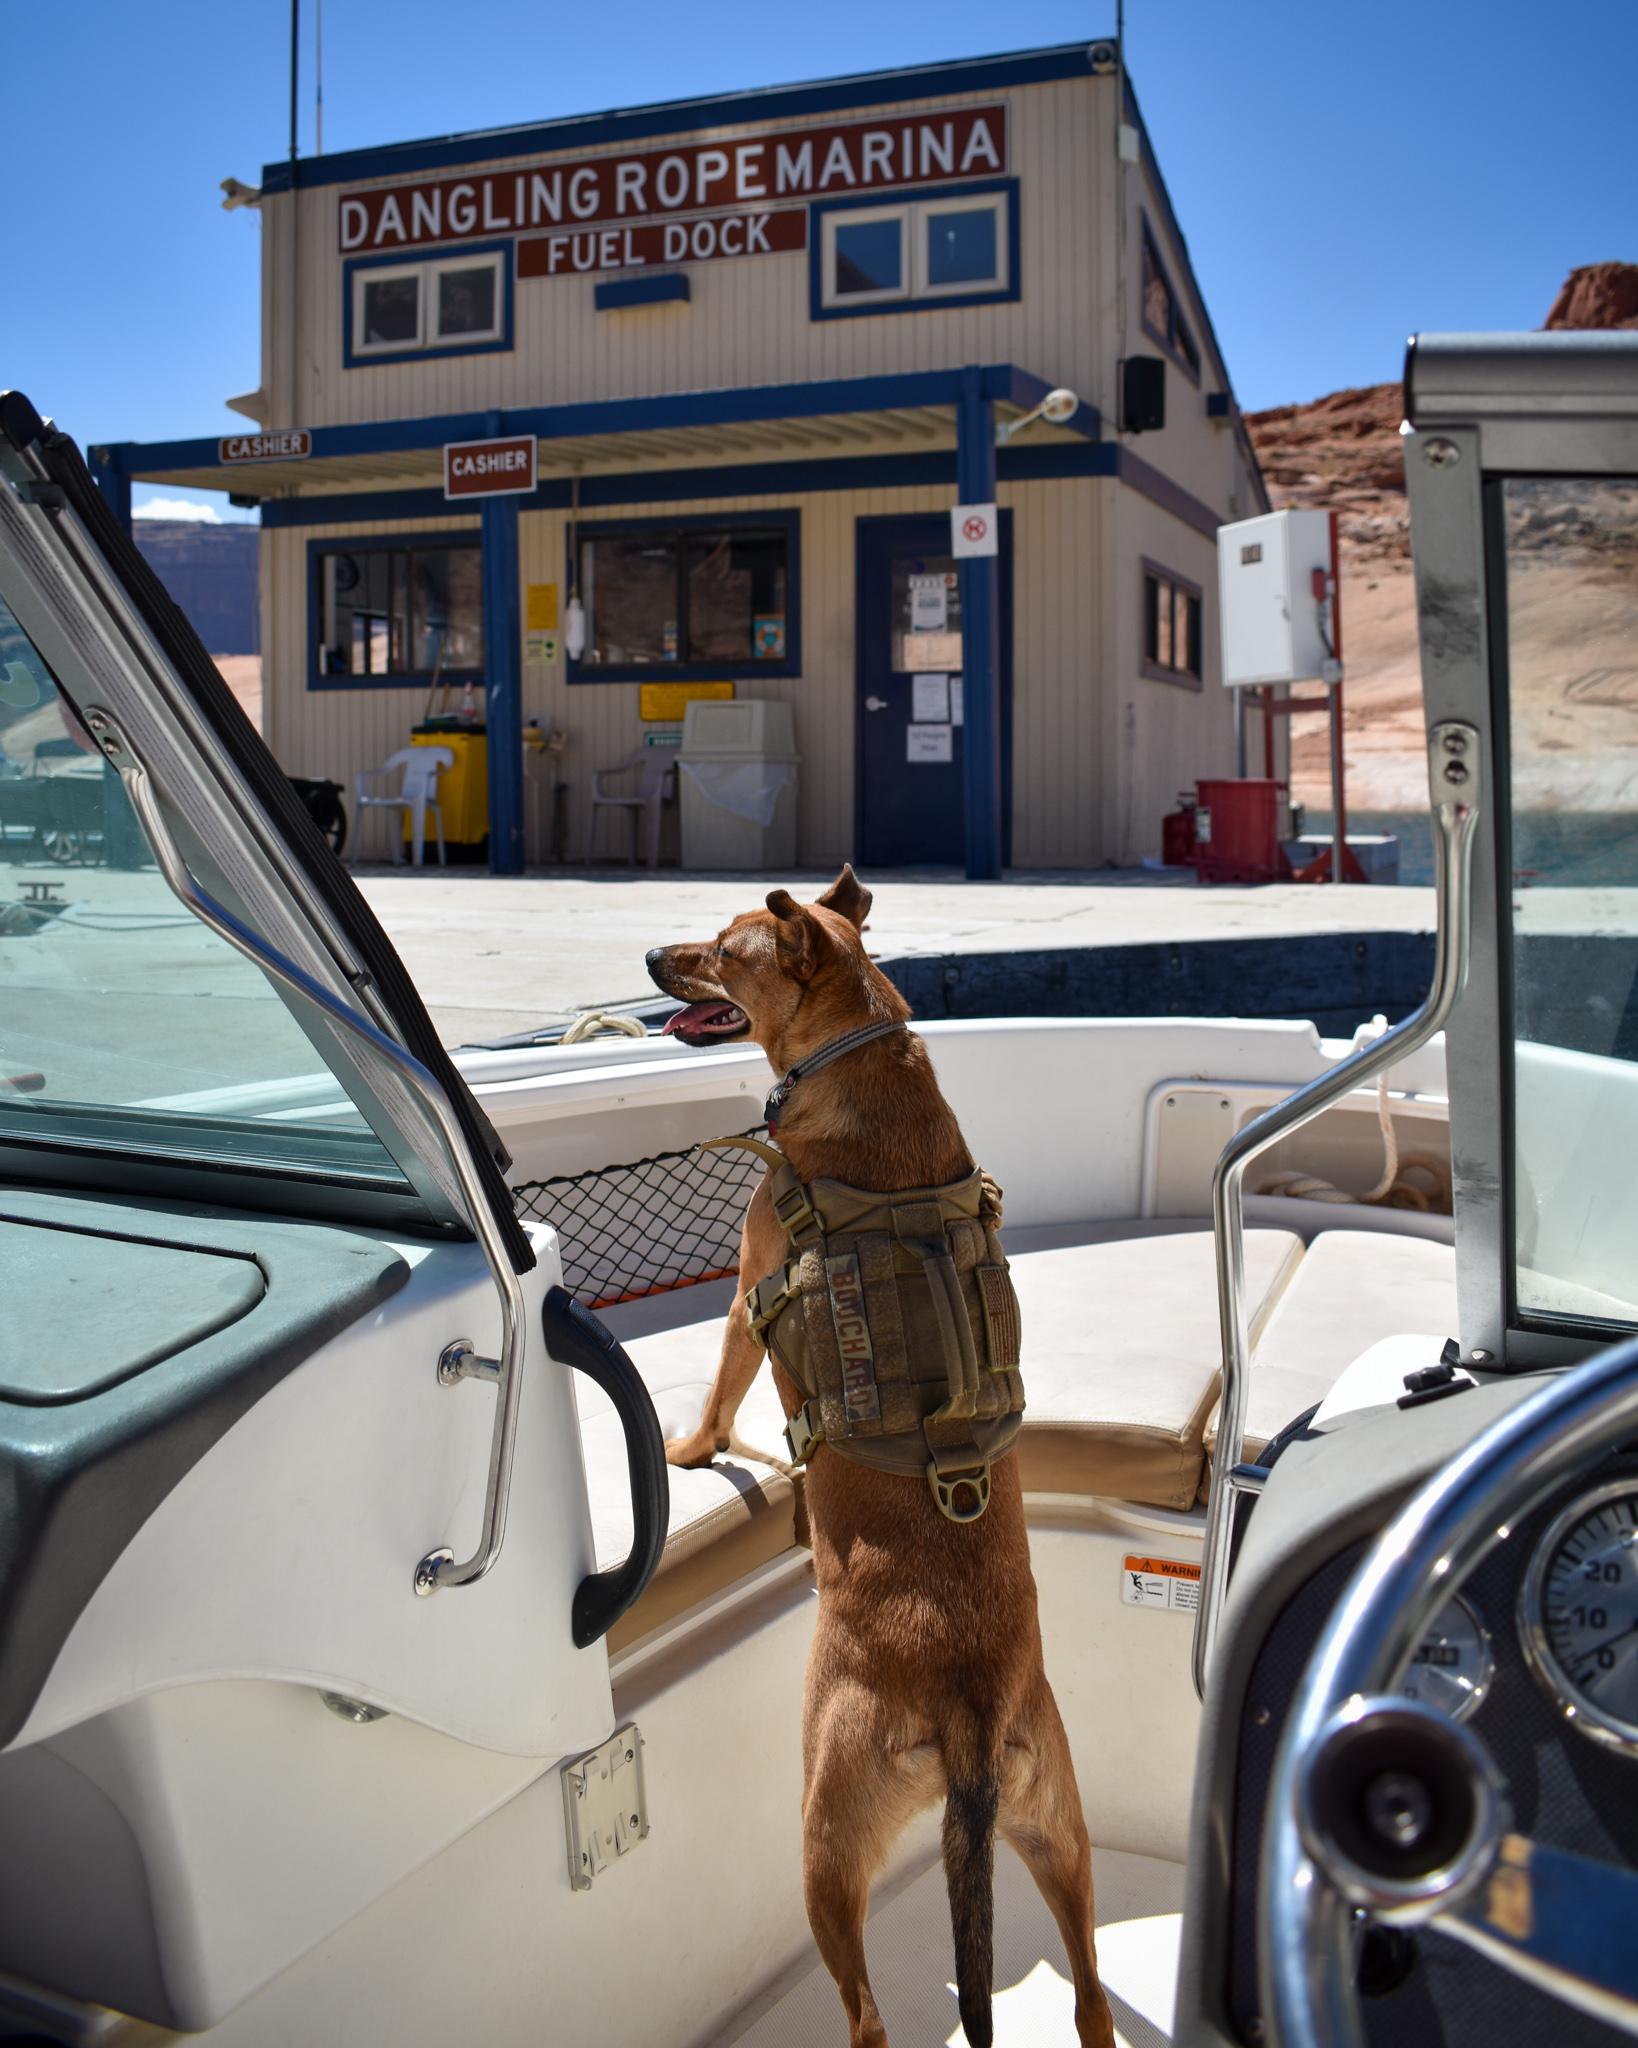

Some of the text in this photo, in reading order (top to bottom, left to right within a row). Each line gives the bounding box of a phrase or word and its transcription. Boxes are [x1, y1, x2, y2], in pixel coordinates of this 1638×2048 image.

[341, 118, 1000, 249] DANGLING ROPE MARINA
[548, 213, 772, 274] FUEL DOCK
[227, 434, 303, 459] CASHIER
[451, 450, 527, 477] CASHIER
[832, 1272, 871, 1406] BOUCHARD
[1161, 1564, 1201, 1578] WARNI
[1584, 1561, 1621, 1584] 20
[1572, 1606, 1607, 1629] 10
[1598, 1649, 1615, 1670] 0
